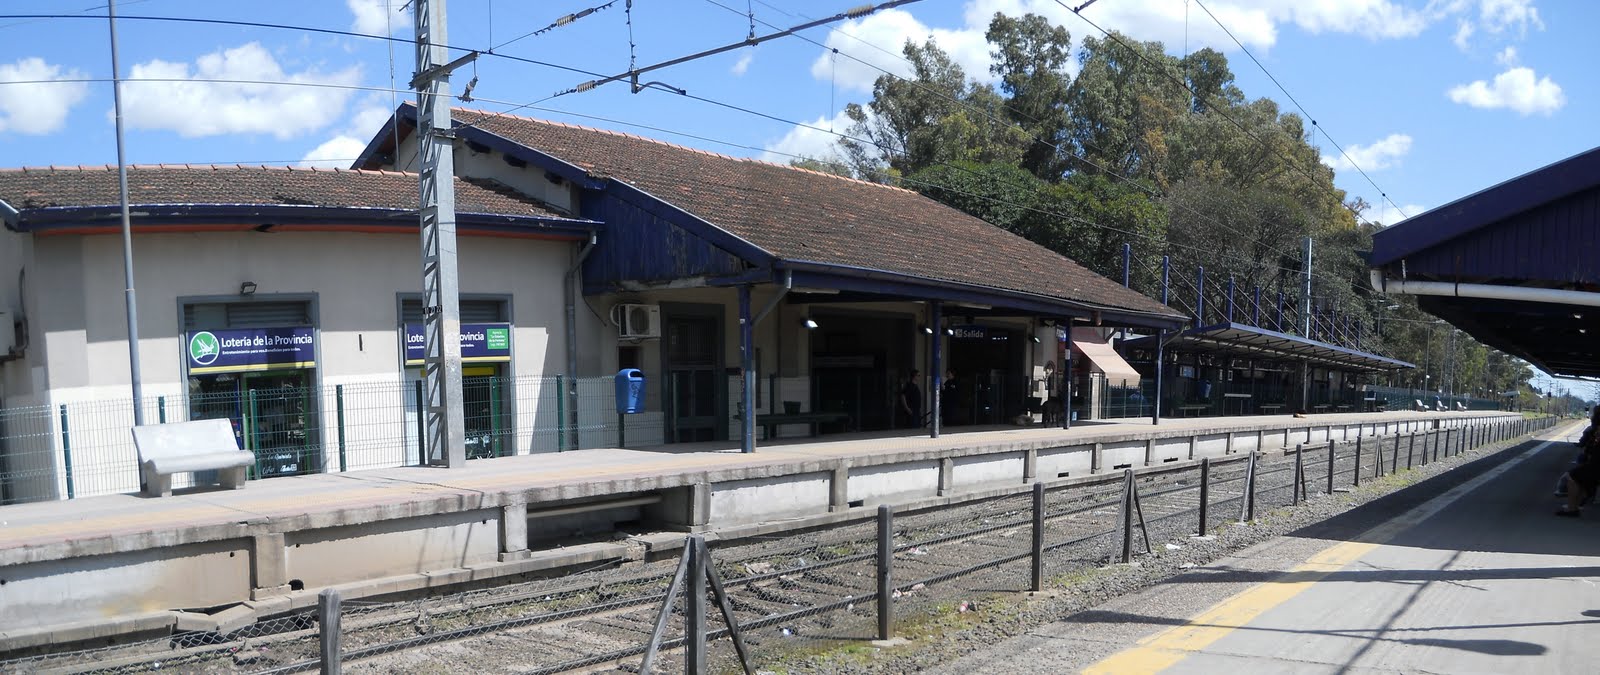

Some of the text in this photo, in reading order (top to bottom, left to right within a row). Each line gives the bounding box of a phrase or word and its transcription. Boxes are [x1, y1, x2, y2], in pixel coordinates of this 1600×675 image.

[407, 333, 424, 343] Lote
[460, 331, 484, 341] ovincia
[963, 330, 984, 338] Salida
[222, 334, 312, 348] Lotería de la Provincia
